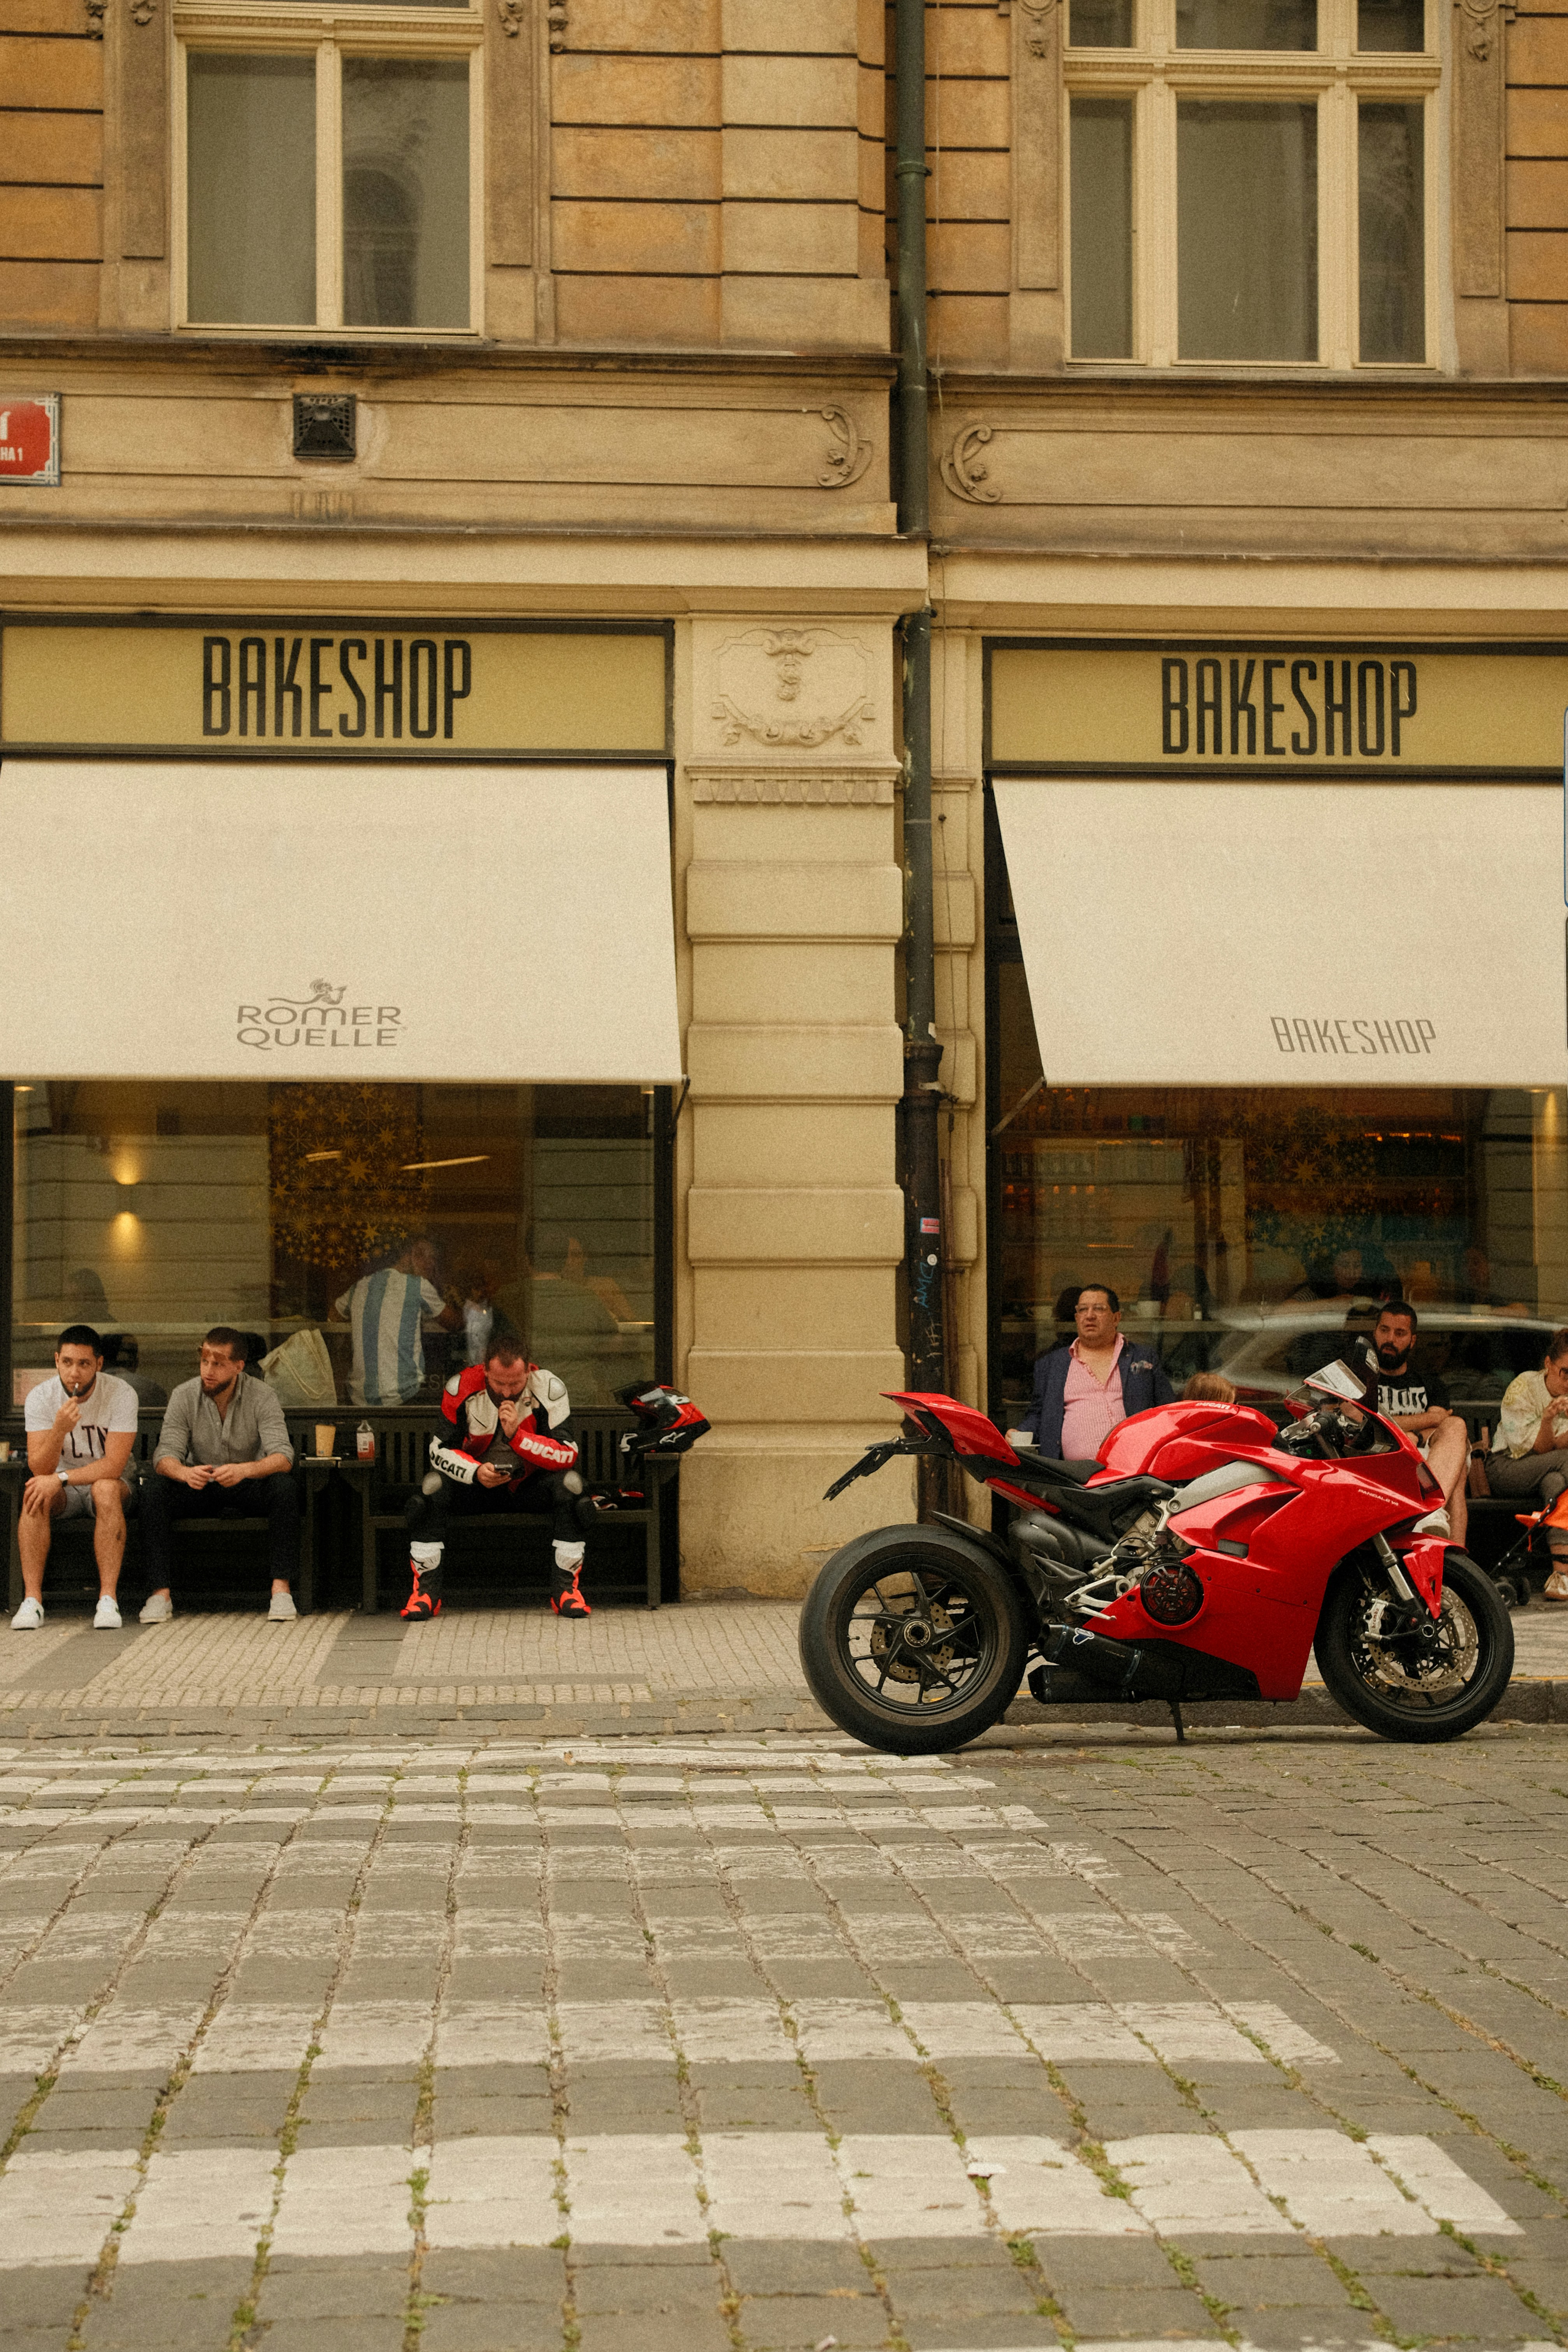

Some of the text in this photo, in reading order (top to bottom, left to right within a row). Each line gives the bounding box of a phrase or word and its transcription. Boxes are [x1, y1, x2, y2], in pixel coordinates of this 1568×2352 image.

[18, 447, 23, 461] 1
[203, 636, 471, 739] BAKESHOP
[1162, 658, 1417, 757] BAKESHOP
[237, 1027, 397, 1050] QUELLE
[1270, 1017, 1436, 1053] BAKESHOP
[519, 1437, 574, 1464] DUCATI
